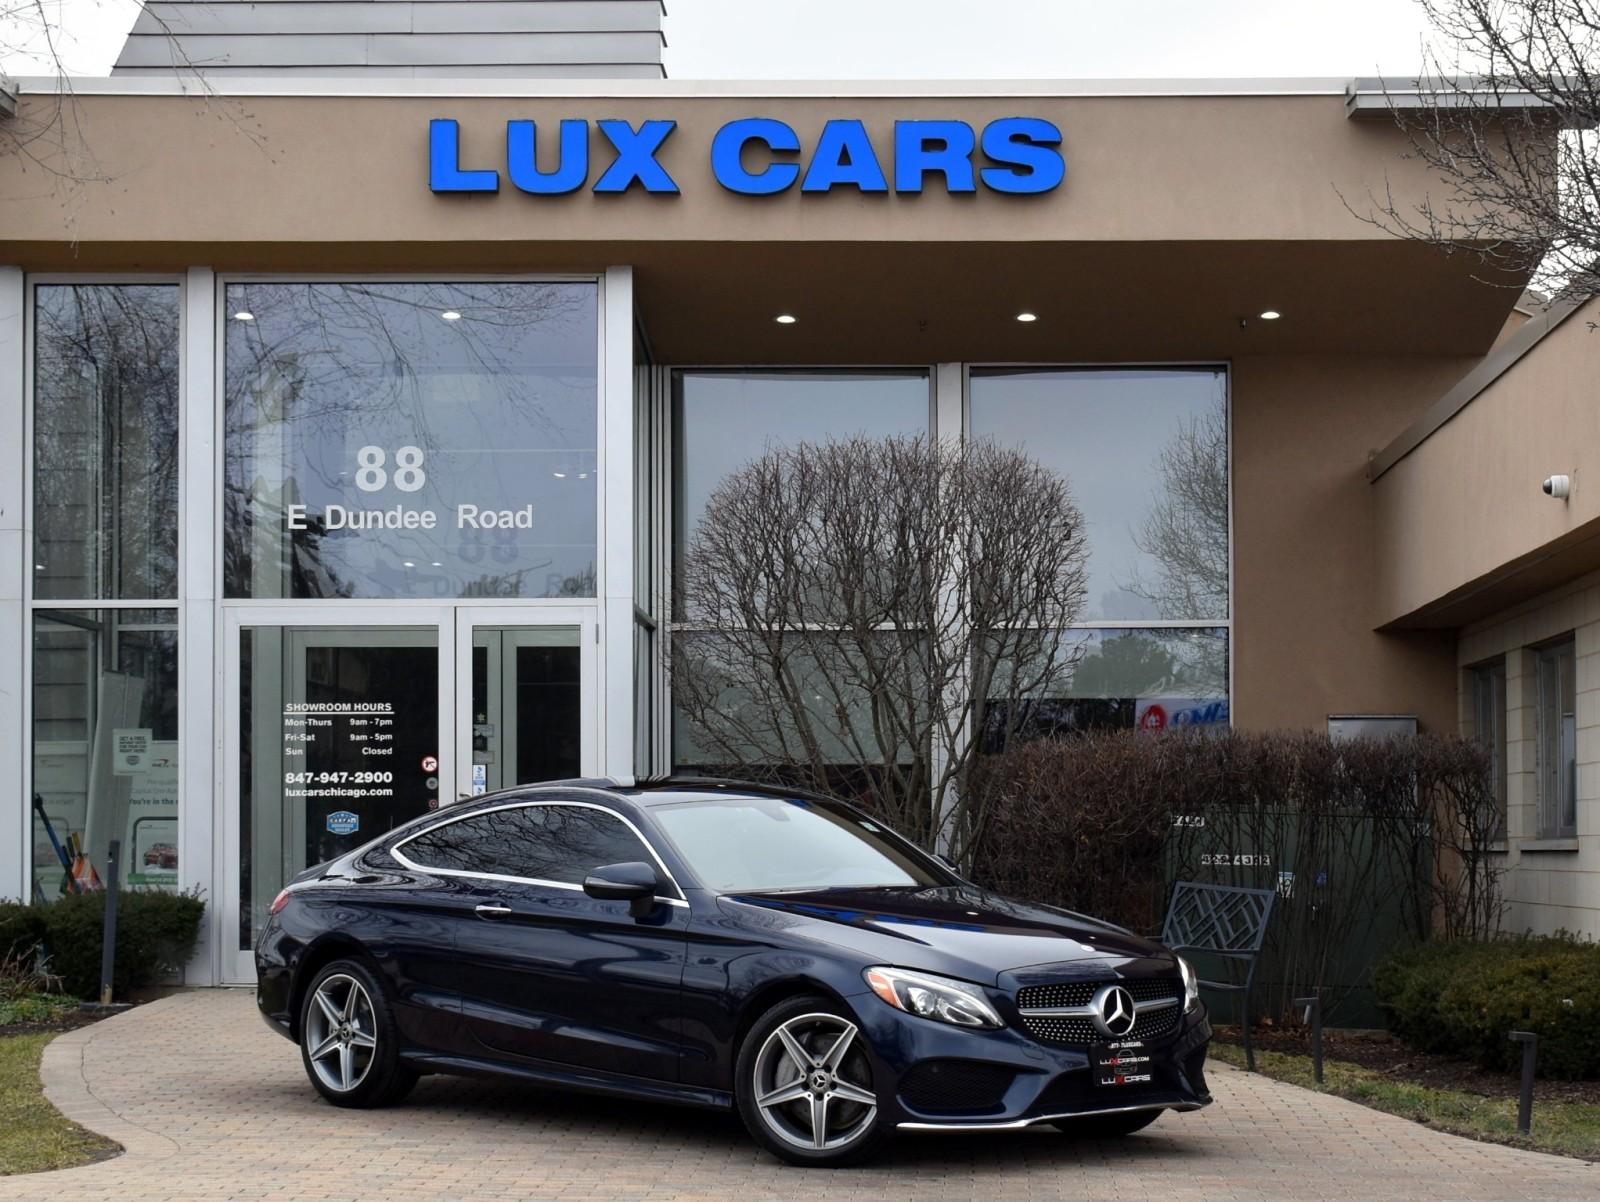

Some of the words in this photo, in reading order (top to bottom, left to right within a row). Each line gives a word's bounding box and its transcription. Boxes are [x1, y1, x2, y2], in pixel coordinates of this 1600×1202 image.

[429, 118, 681, 195] LUX
[711, 117, 1066, 195] CARS
[355, 445, 426, 492] 88
[288, 505, 307, 530] E
[325, 504, 437, 530] Dundee
[457, 504, 533, 530] Road
[285, 703, 351, 711] SHOWROOM
[353, 703, 392, 711] HOURS
[284, 718, 332, 726] Mon-Thurs
[349, 718, 368, 727] 9am
[374, 717, 393, 727] 7pm
[284, 733, 316, 742] Fri-Sat
[349, 733, 368, 742] 9am
[374, 732, 393, 742] 5pm
[285, 747, 303, 755] Sun
[361, 746, 393, 755] Closed
[284, 771, 393, 783] 847-947-2900
[285, 787, 394, 798] luxcarschicago.com
